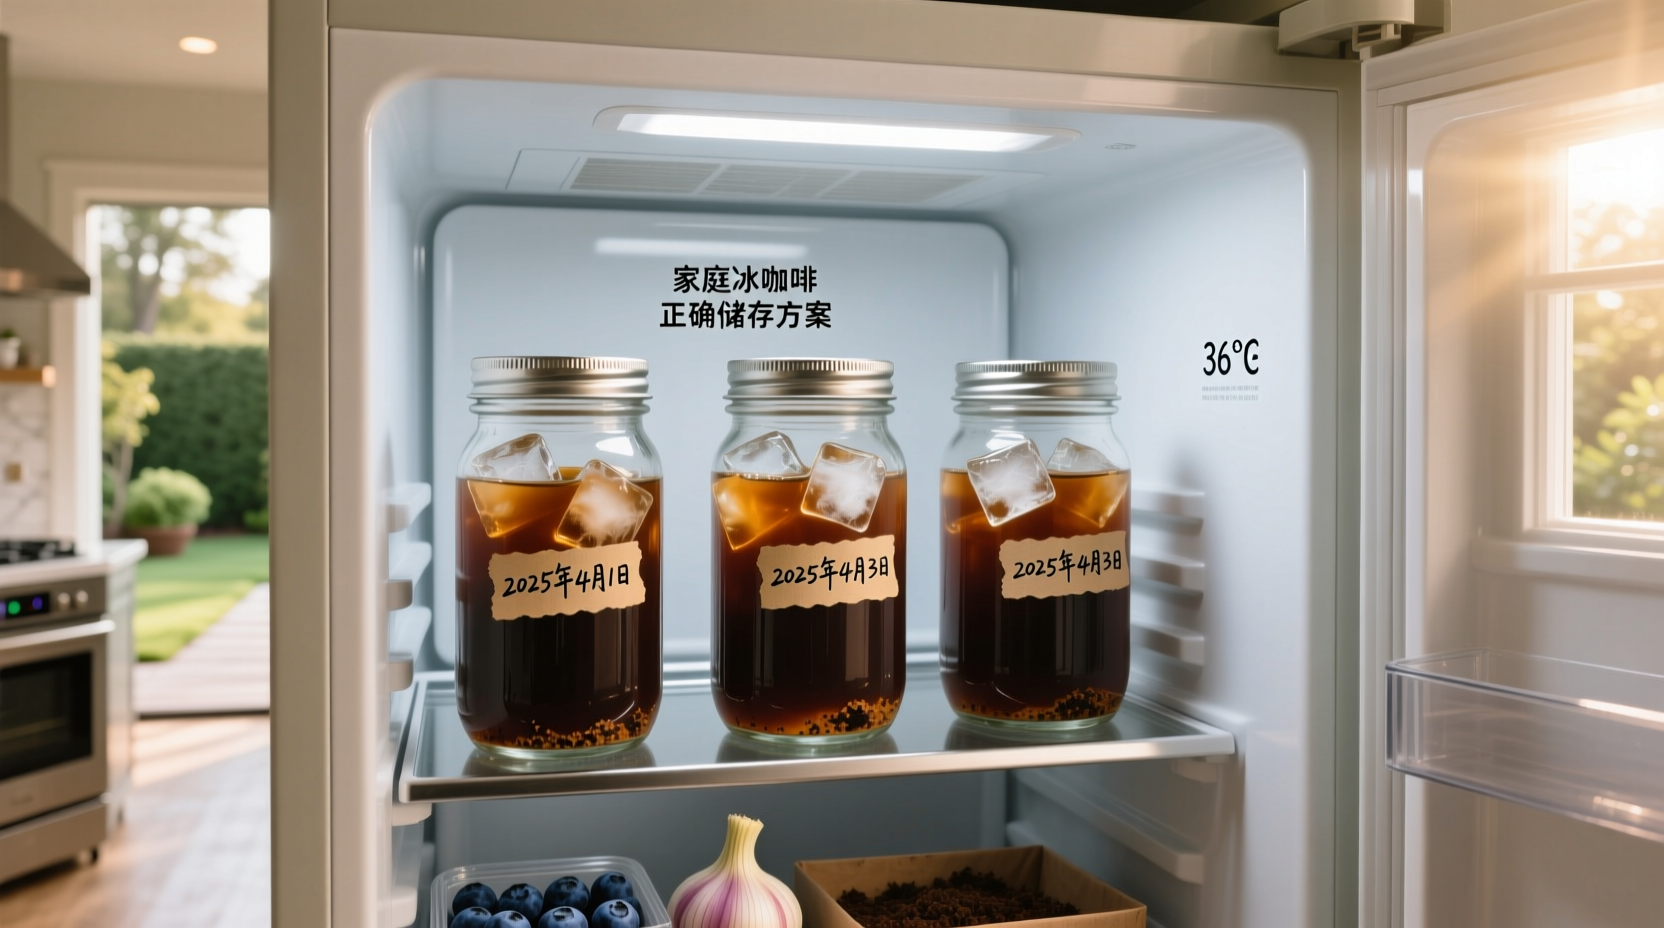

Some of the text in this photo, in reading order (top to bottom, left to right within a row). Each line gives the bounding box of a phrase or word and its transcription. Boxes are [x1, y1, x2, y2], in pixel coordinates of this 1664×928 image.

[673, 264, 818, 294] 家庭冰咖啡
[659, 299, 832, 330] 正确储存方案
[502, 562, 630, 600] 2025年4月1日
[770, 555, 889, 591] 2025年4月3日
[1012, 549, 1122, 583] 2025年4月3日
